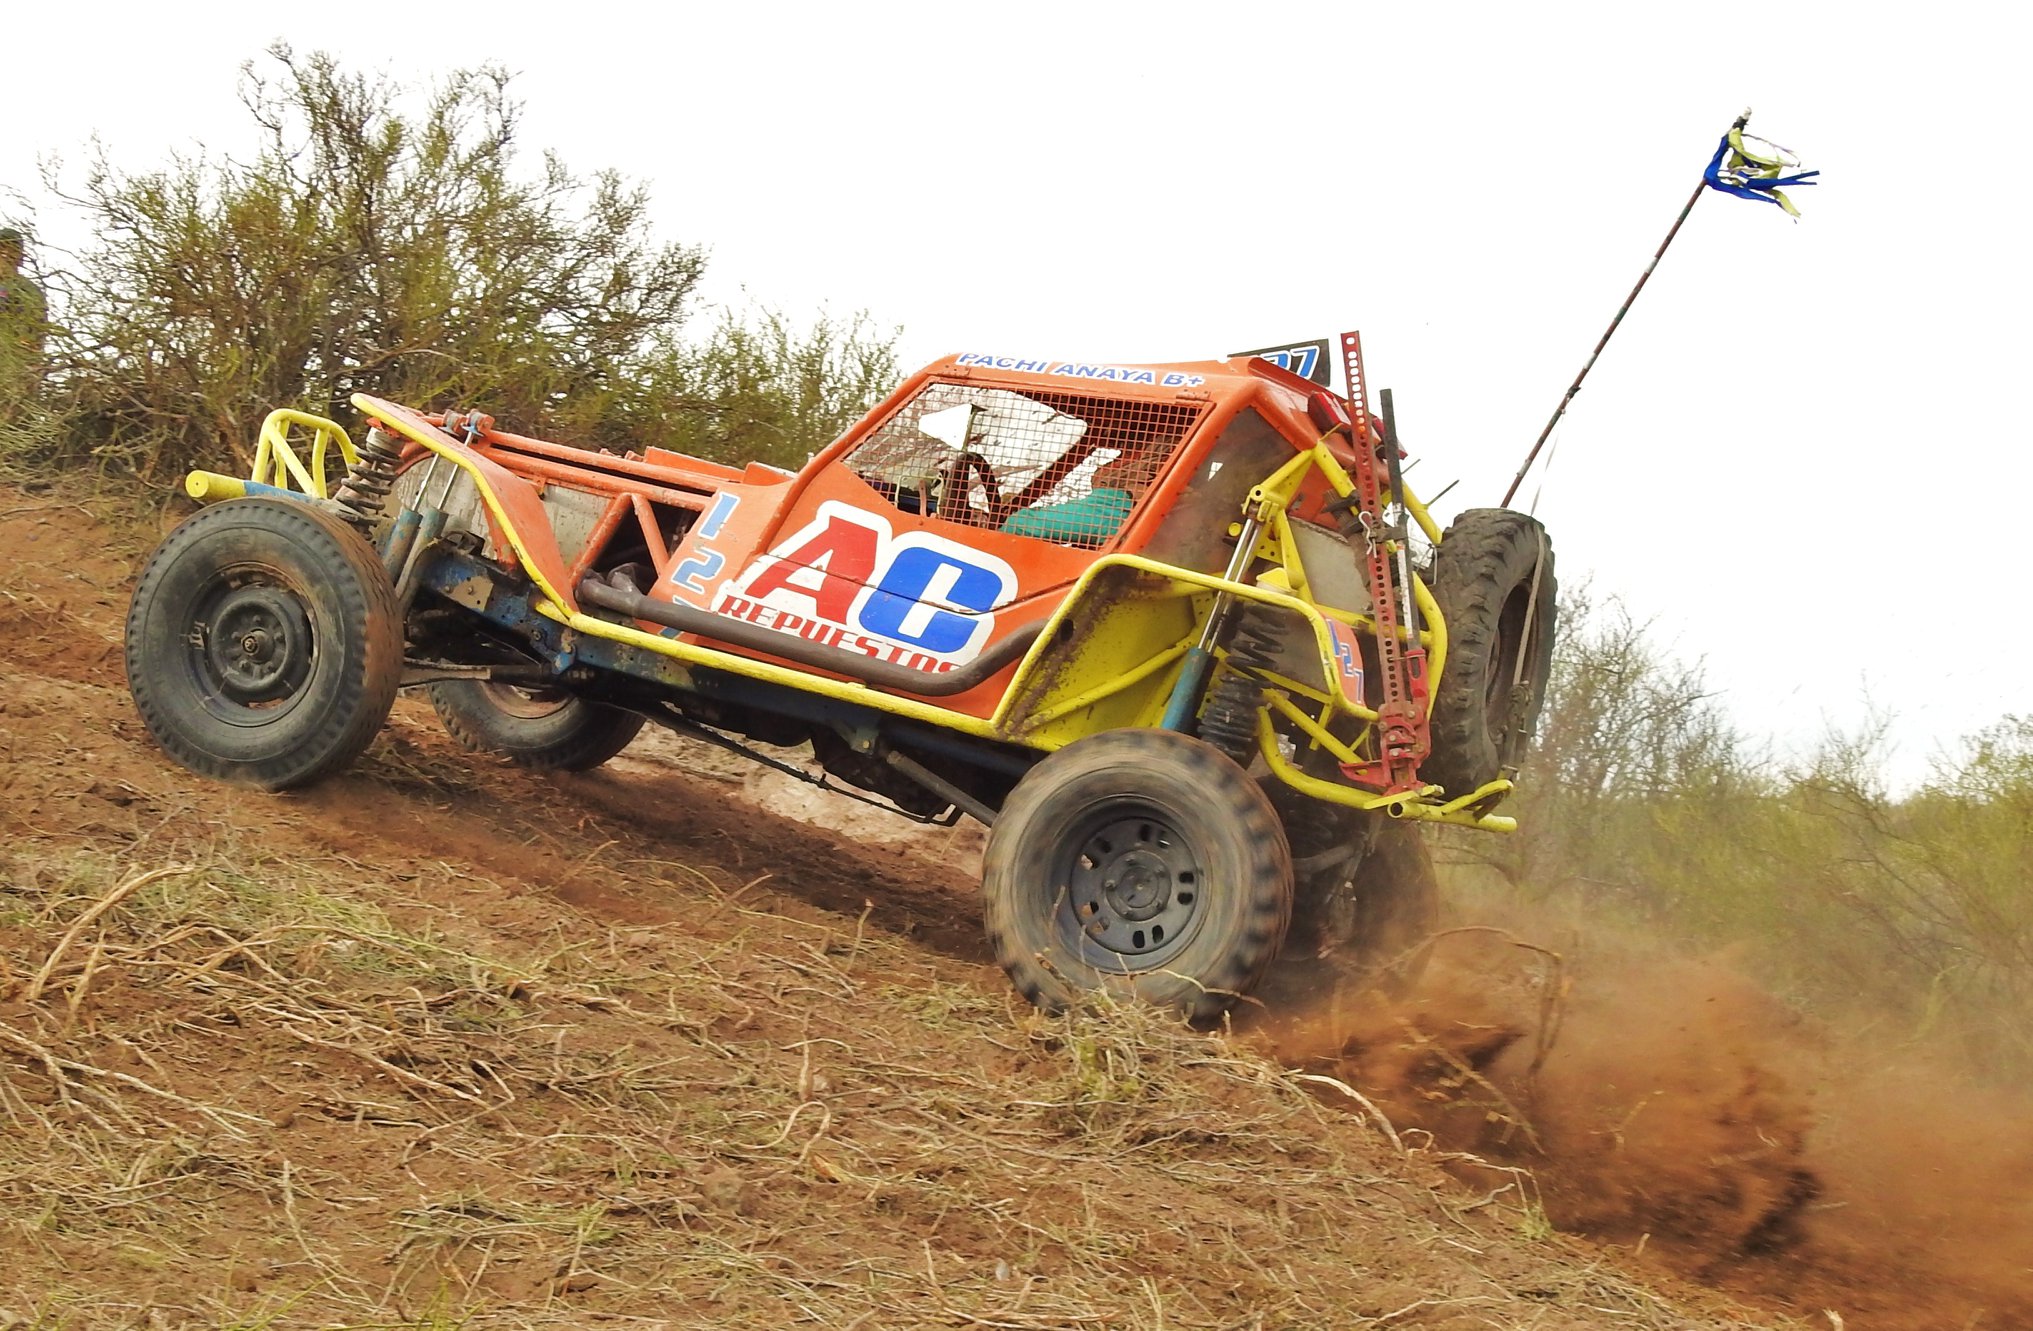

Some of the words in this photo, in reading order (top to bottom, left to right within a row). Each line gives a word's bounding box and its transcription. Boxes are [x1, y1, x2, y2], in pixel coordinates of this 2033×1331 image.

[957, 352, 1048, 373] PACHI
[1053, 363, 1155, 384] ANAYA
[1162, 373, 1204, 387] B+
